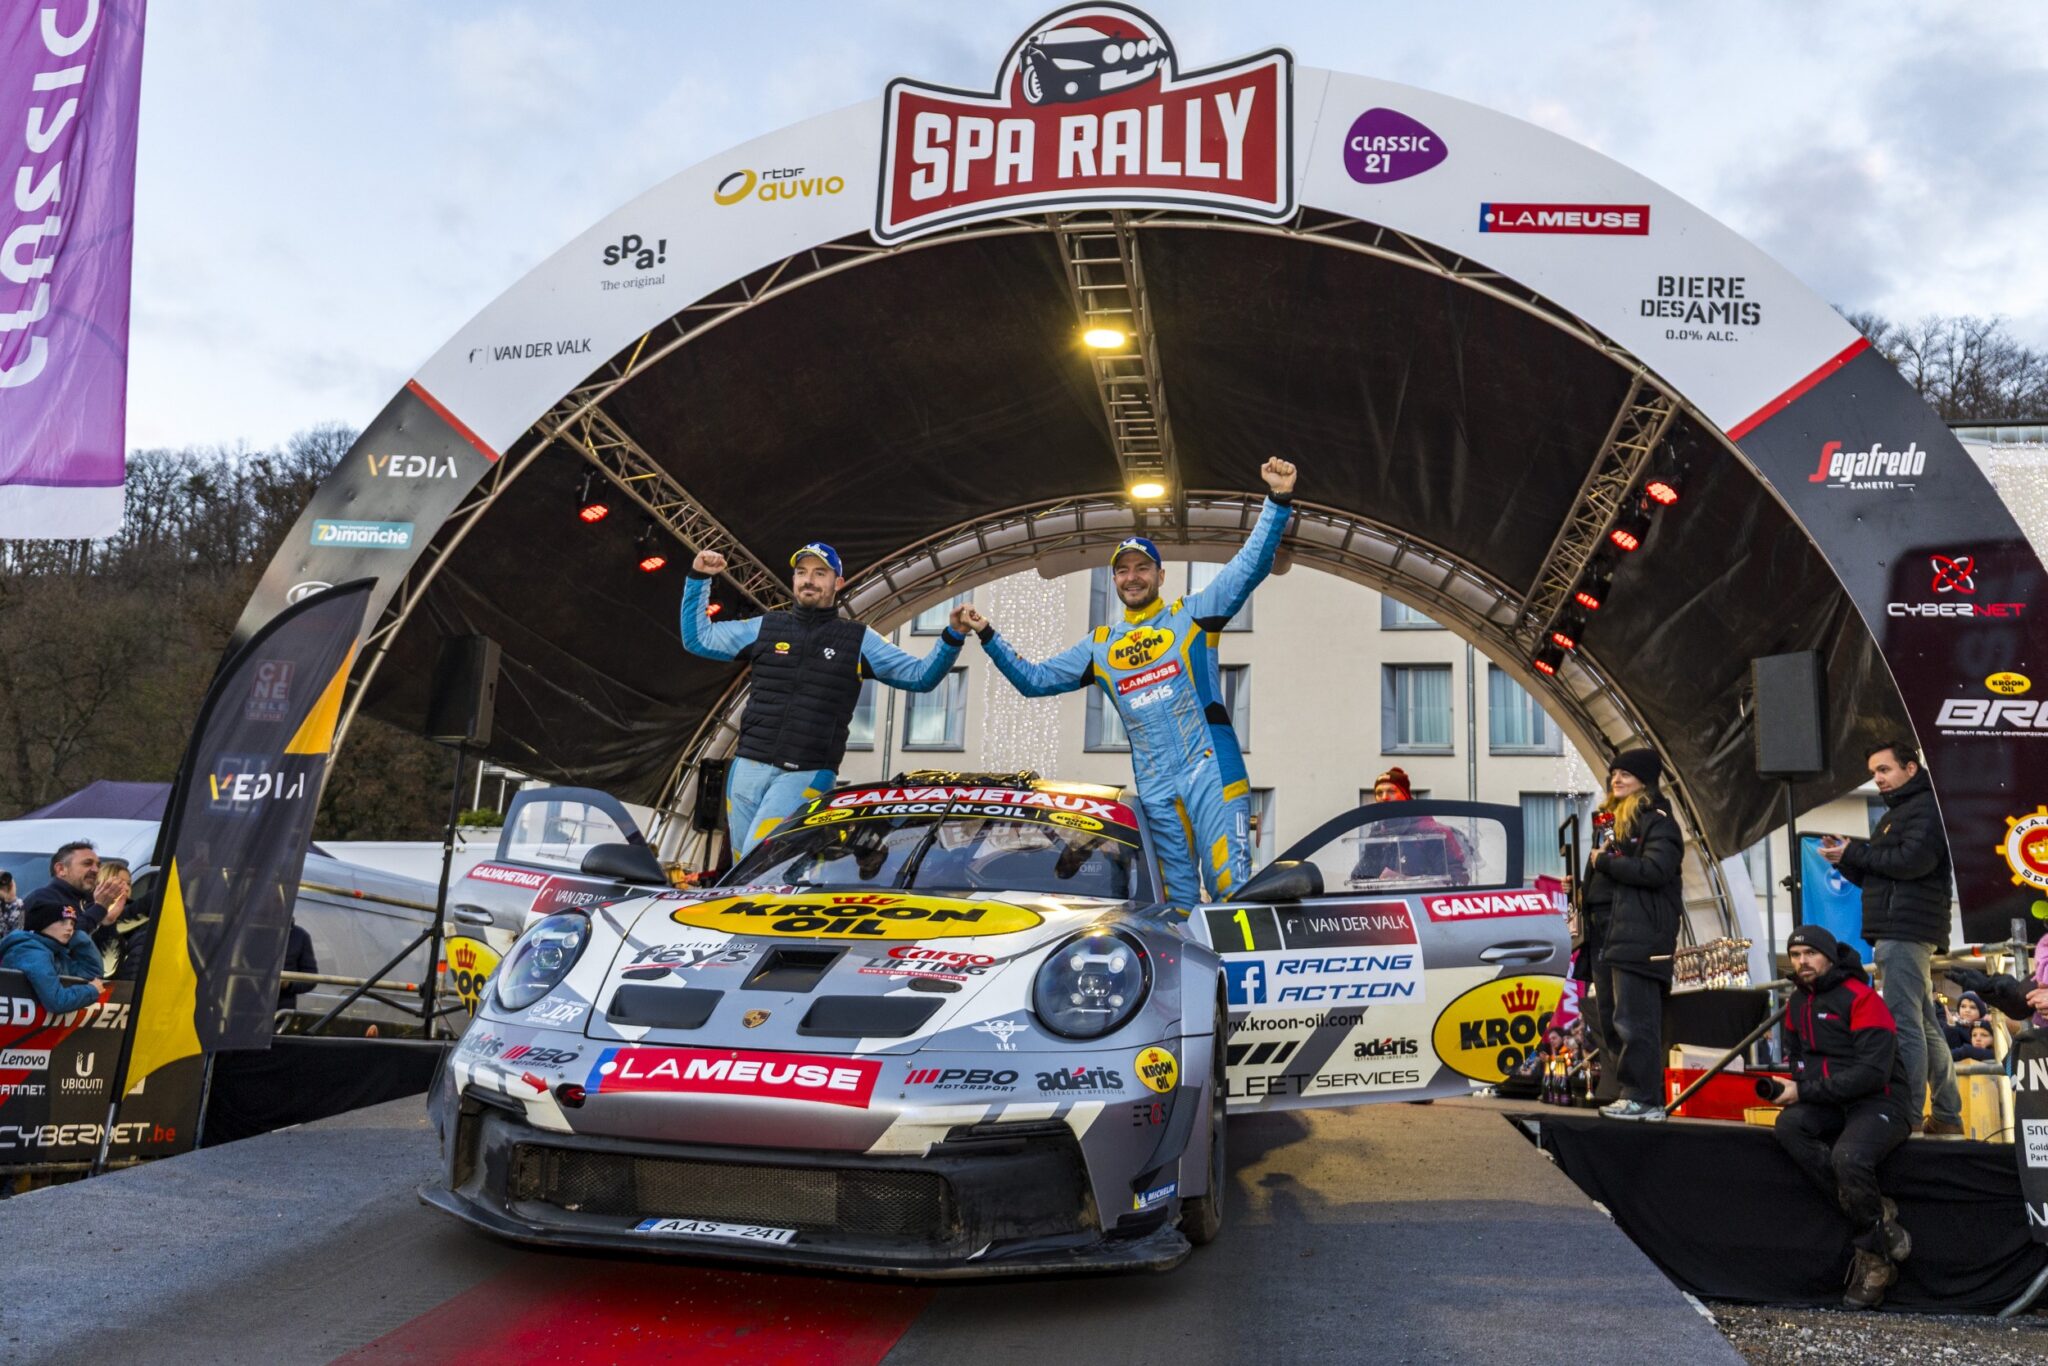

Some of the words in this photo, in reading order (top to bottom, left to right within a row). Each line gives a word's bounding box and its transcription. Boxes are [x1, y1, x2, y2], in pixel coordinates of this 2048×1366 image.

[909, 110, 1036, 202] SPA
[1057, 85, 1257, 182] RALLY
[1350, 134, 1431, 153] CLASSIC
[762, 167, 805, 180] rtbf
[1364, 153, 1392, 174] 21
[758, 175, 844, 202] auvio
[602, 233, 667, 270] spa!
[600, 279, 620, 291] The
[623, 274, 666, 291] original
[1658, 276, 1745, 299] BIERE
[1666, 329, 1702, 341] 0.0%
[1706, 330, 1738, 342] ALC.
[494, 345, 522, 362] VAN
[525, 342, 553, 358] DER
[556, 338, 592, 356] VALK
[367, 454, 458, 478] VEDIA
[1808, 440, 1926, 483] Segafredo
[1849, 481, 1894, 490] ZANETTI
[1887, 603, 2027, 618] CYBERNET
[1115, 633, 1164, 660] KROON
[1129, 652, 1153, 667] OIL
[209, 772, 305, 801] VEDIA
[830, 787, 1116, 820] GALVAMETAUX
[2015, 818, 2048, 835] R.A.
[472, 866, 545, 886] GALVAMETAUX
[555, 889, 575, 903] VAN
[574, 892, 594, 905] DER
[1432, 893, 1553, 917] GALVAMET
[720, 900, 989, 923] KROON
[772, 917, 886, 936] OIL
[1233, 909, 1255, 951] 1
[1309, 917, 1340, 933] VAN
[1342, 917, 1371, 931] DER
[1372, 915, 1409, 930] VALK
[630, 944, 753, 968] feys
[669, 941, 758, 951] printing
[864, 958, 989, 976] LIFTING
[887, 946, 996, 969] Cargo
[1276, 954, 1414, 975] RACING
[1277, 981, 1415, 1003] ACTION
[543, 1002, 585, 1023] JDR
[518, 1047, 580, 1064] PBO
[1354, 1036, 1418, 1058] adéris
[1, 1053, 46, 1066] Lenovo
[937, 1068, 1020, 1085] PBO
[1035, 1066, 1124, 1091] adéris
[1141, 1061, 1174, 1079] KROON
[61, 1078, 104, 1090] UBIQUITI
[933, 1083, 1017, 1092] MOTORSPORT
[1156, 1077, 1171, 1091] OIL
[1226, 1073, 1310, 1098] LEET
[1316, 1069, 1420, 1088] SERVICES
[2031, 1153, 2048, 1161] Part
[1147, 1184, 1176, 1201] MICHELIN
[659, 1220, 720, 1233] AAS
[740, 1227, 787, 1241] 241
